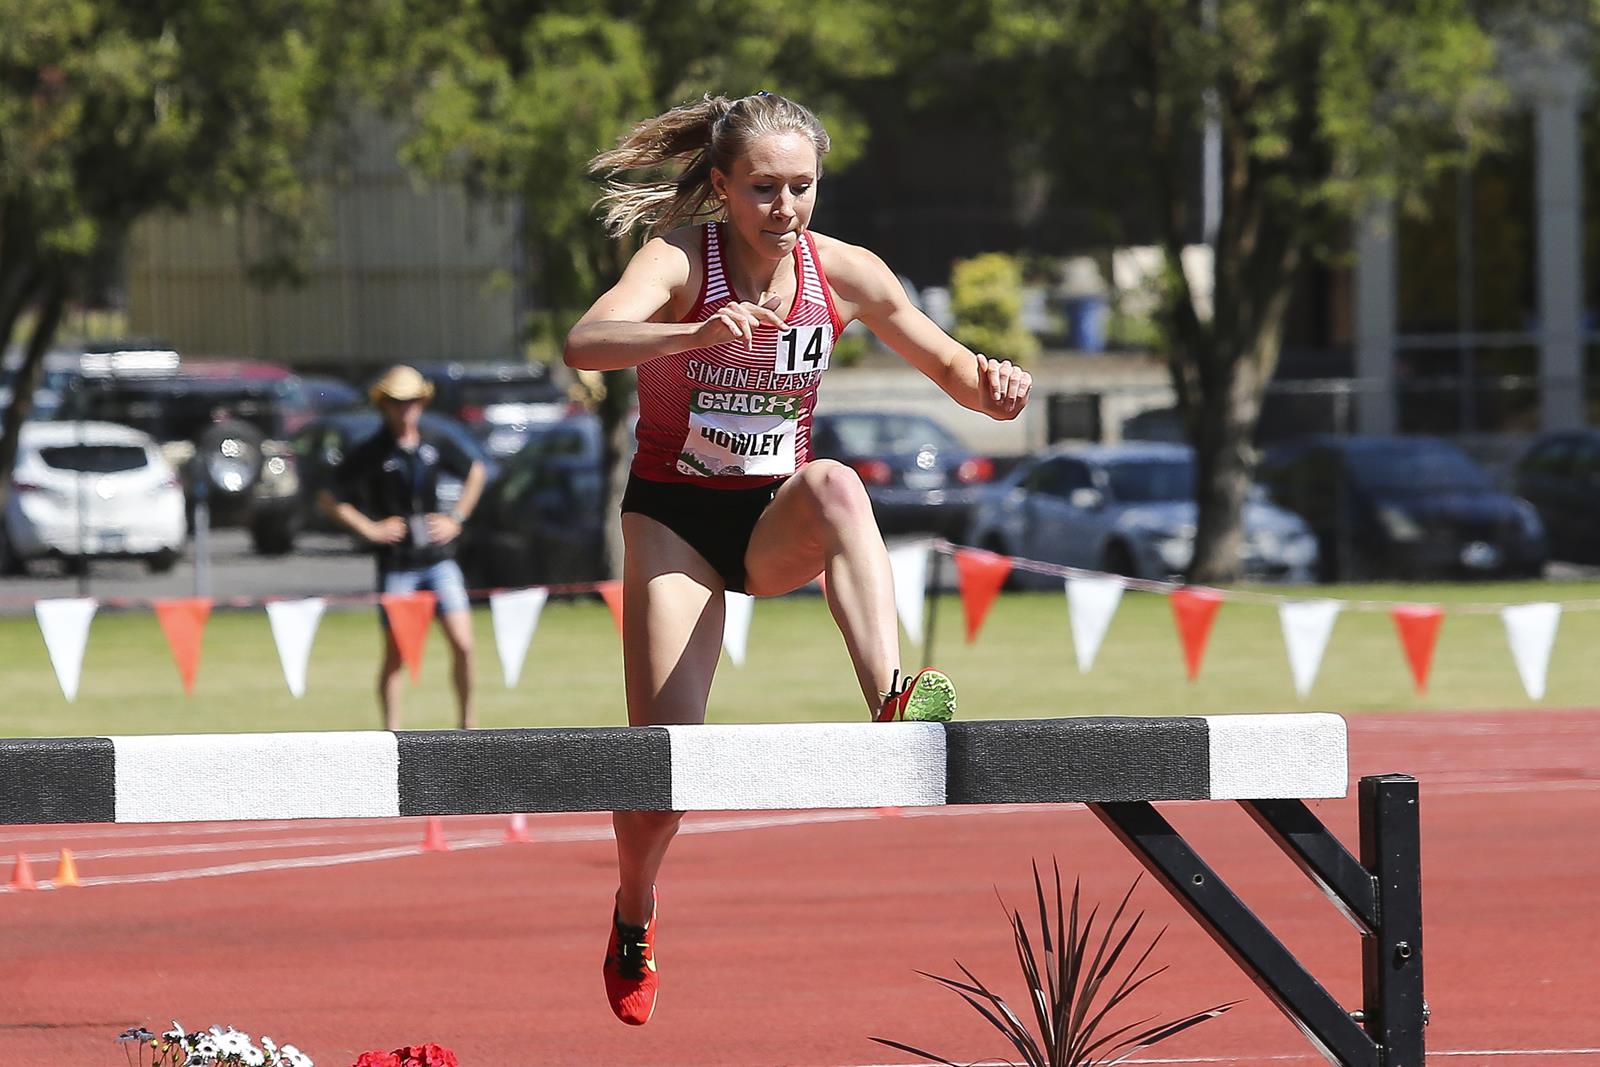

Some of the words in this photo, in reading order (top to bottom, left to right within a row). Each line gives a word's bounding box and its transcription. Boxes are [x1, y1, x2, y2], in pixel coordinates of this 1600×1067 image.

[781, 327, 823, 371] 14
[686, 360, 749, 388] SIMON
[697, 391, 765, 413] GNAC
[700, 426, 785, 456] HOWLEY
